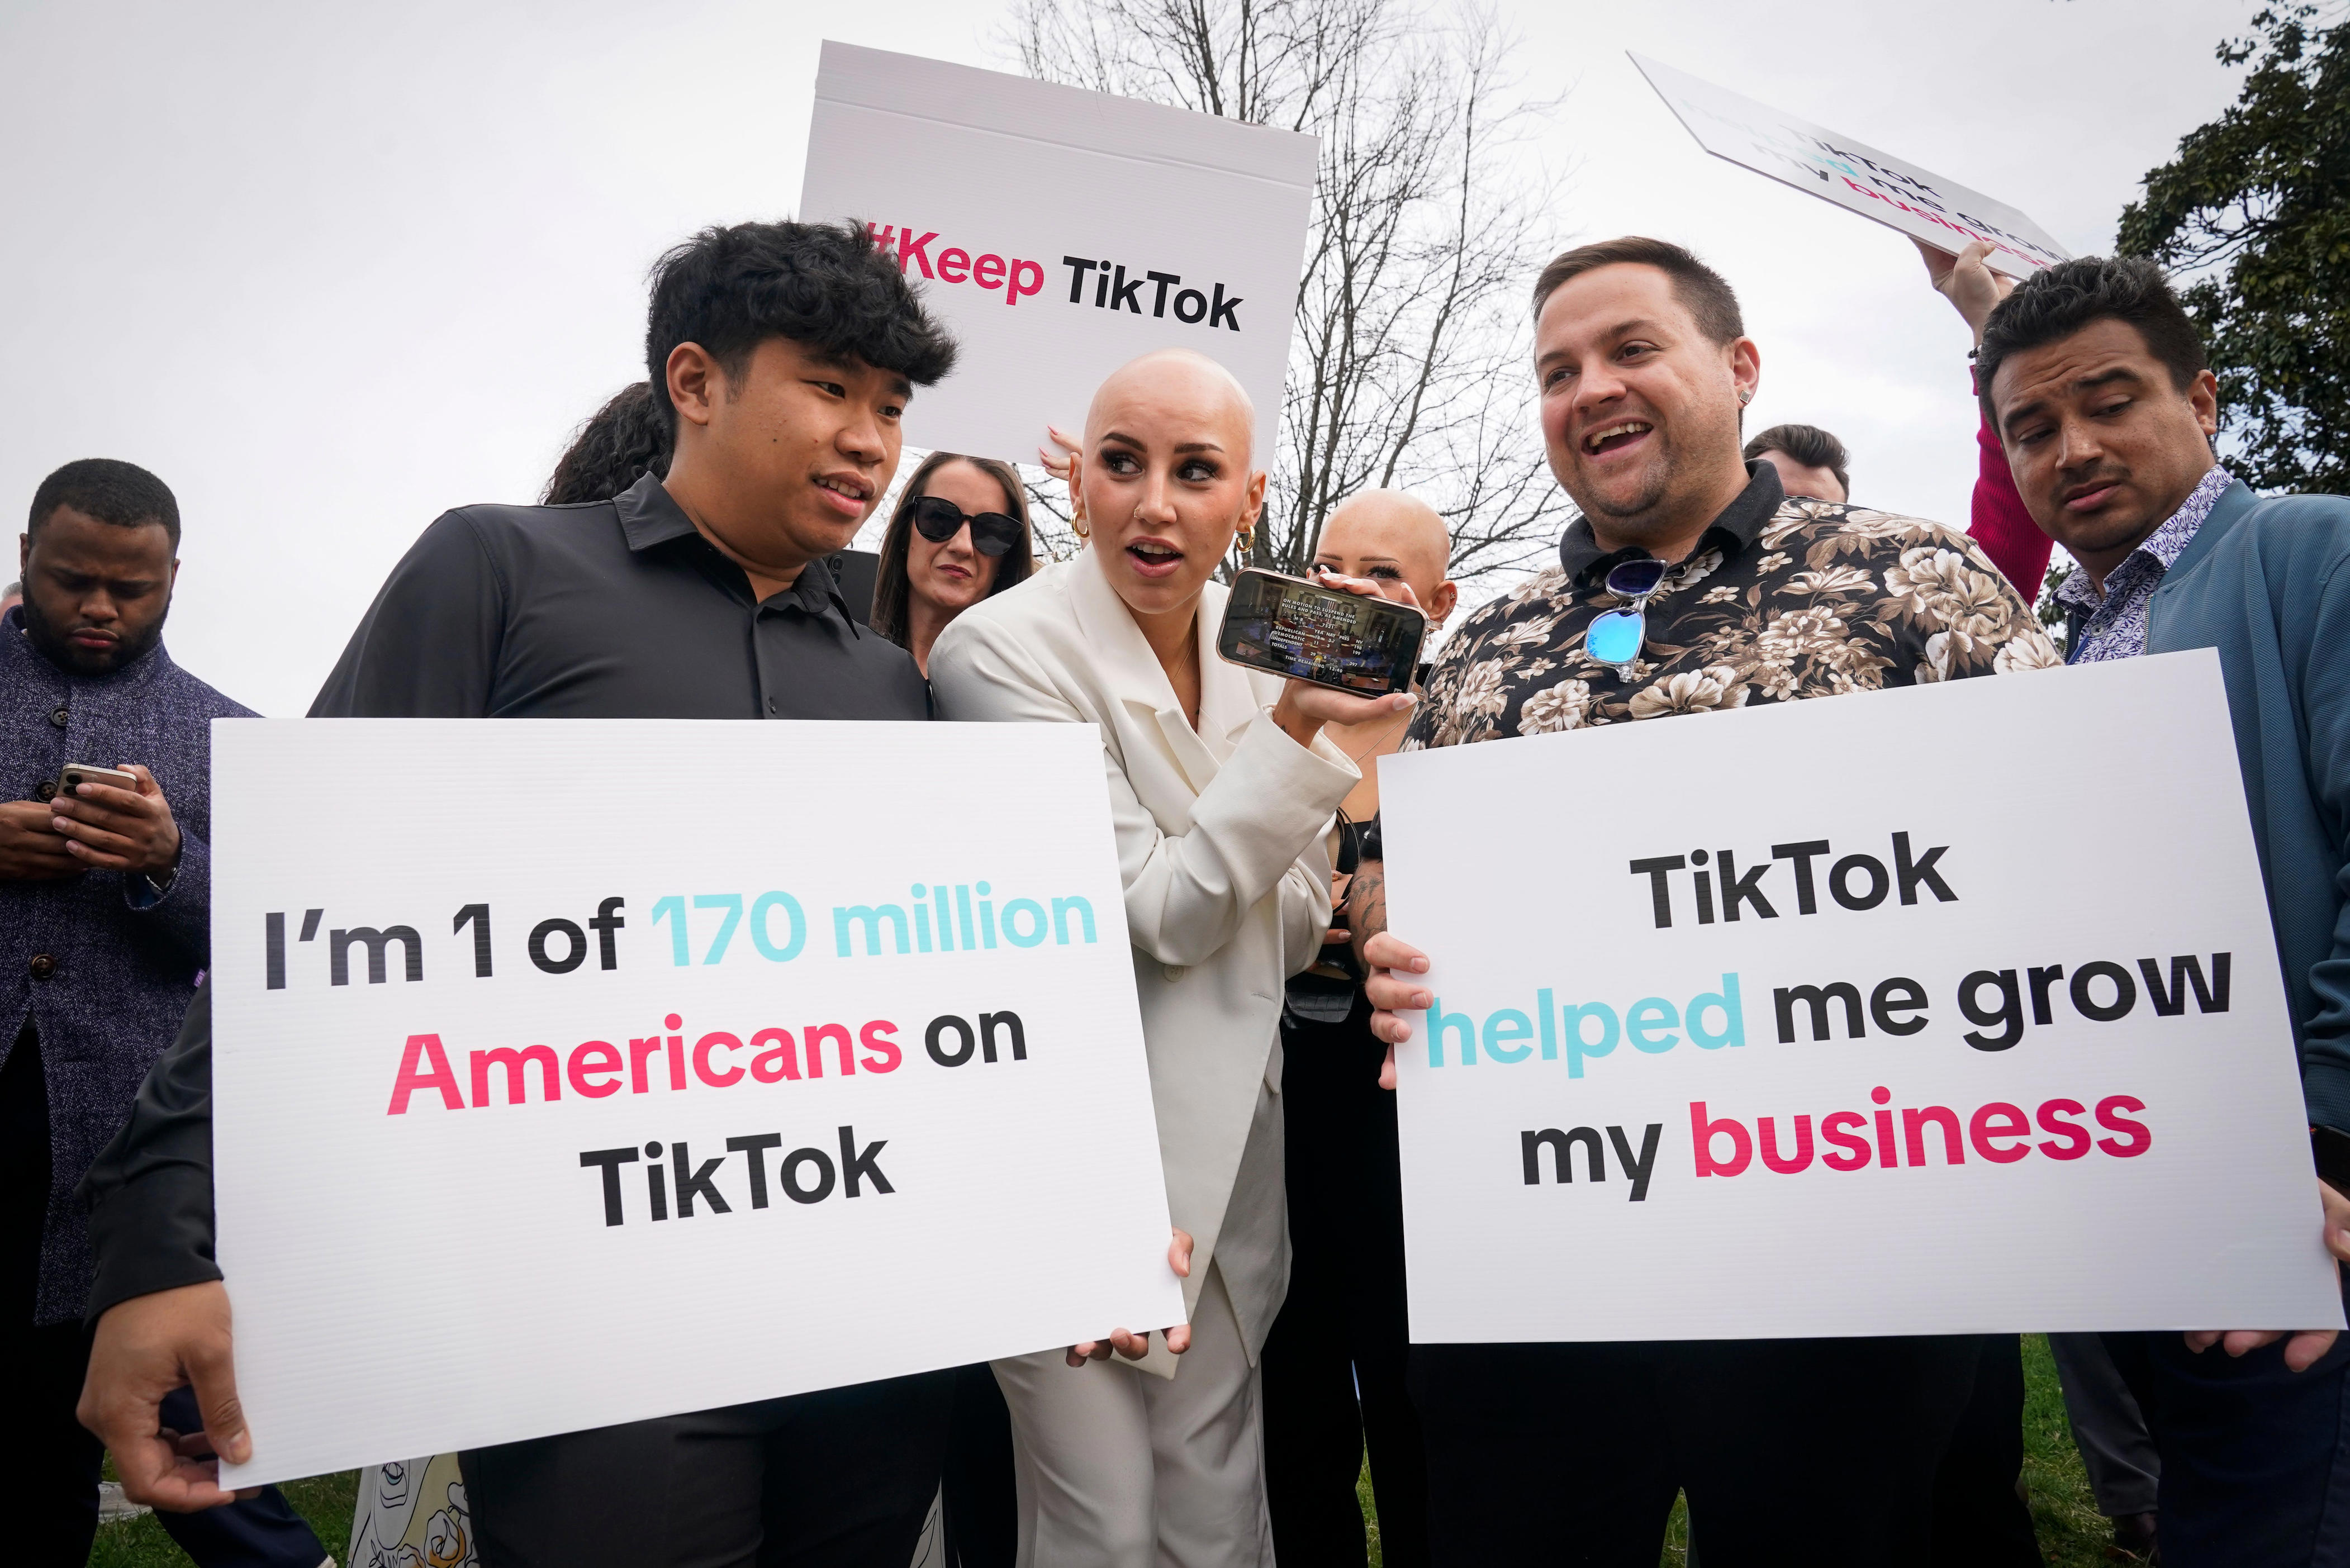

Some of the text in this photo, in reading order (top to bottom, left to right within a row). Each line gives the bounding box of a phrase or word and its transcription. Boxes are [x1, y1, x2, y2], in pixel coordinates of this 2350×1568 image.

[1777, 123, 1943, 199] TikTok
[1868, 175, 1948, 212] me
[864, 222, 1244, 332] #Keep TikTok
[1274, 631, 1305, 642] DEMOCRATIC
[1275, 625, 1305, 636] REPUBLICAN
[1322, 607, 1344, 616] SUSPEND
[1332, 615, 1356, 624] AMENDED
[1298, 658, 1324, 668] REMAINING
[1629, 831, 1959, 929] TikTok
[453, 904, 492, 978] 1
[528, 896, 625, 975] of
[652, 891, 806, 967] 170
[833, 881, 1098, 958] million
[1426, 952, 2232, 1078] helped me grow
[387, 1010, 1028, 1116] Americans on
[580, 1125, 896, 1227] TikTok
[1521, 1086, 2152, 1202] my business
